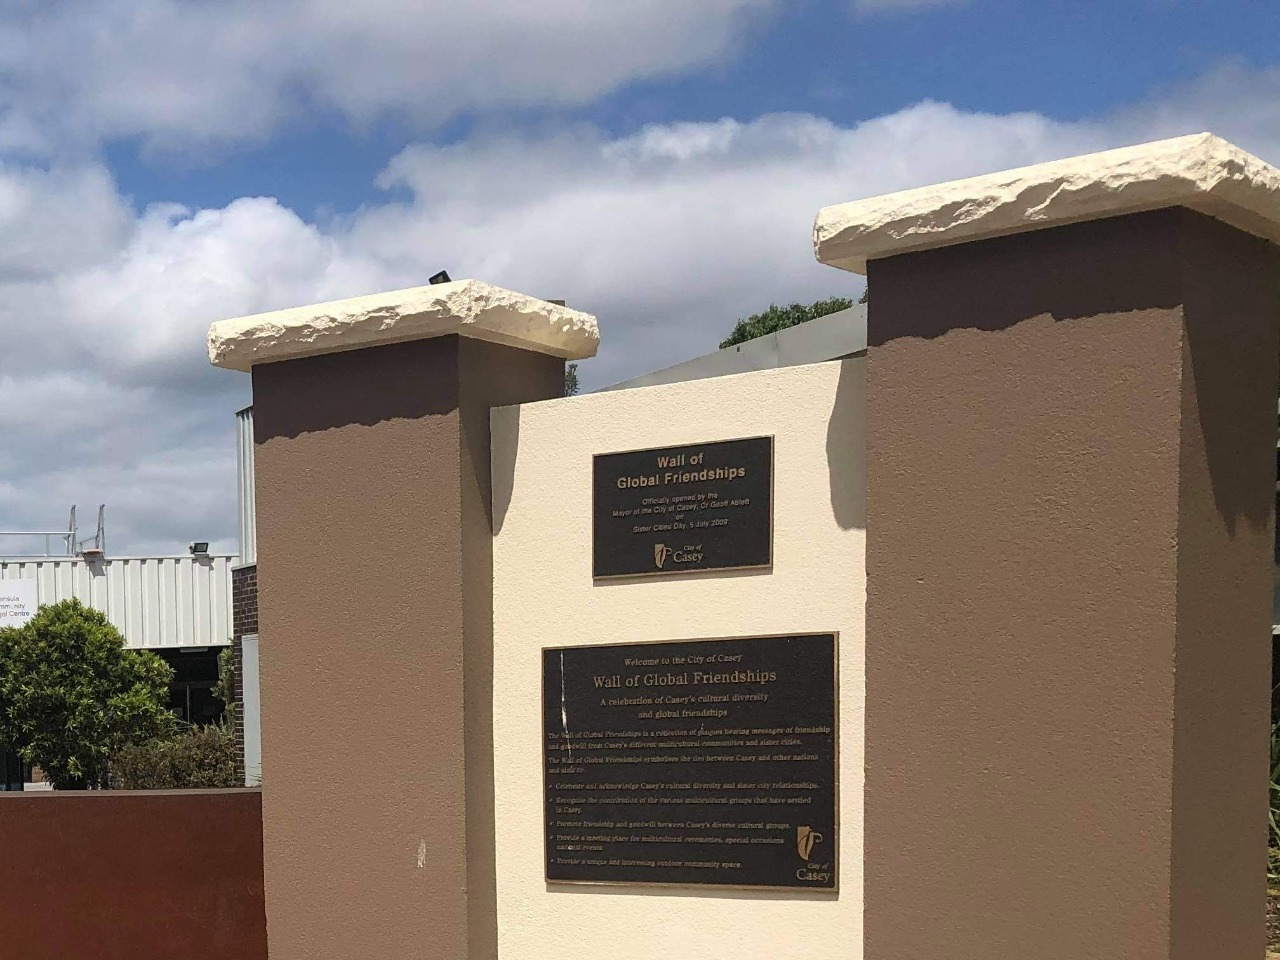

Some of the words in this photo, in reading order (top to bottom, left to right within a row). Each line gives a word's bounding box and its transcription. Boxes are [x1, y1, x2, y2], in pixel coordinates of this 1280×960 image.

[657, 454, 684, 468] Wall
[690, 453, 704, 464] of
[617, 474, 660, 488] Global
[664, 467, 746, 485] Friendships
[672, 494, 696, 503] opened
[698, 493, 706, 501] by
[654, 506, 666, 514] City
[710, 518, 728, 526] 2009
[674, 550, 704, 563] Casey
[624, 658, 659, 666] Welcome
[672, 656, 684, 664] the
[688, 656, 704, 664] City
[706, 655, 716, 663] of
[718, 654, 742, 662] Casey
[594, 676, 621, 688] Wall
[626, 675, 640, 687] of
[644, 672, 688, 686] Global
[694, 670, 777, 684] Friendships
[608, 696, 652, 706] celebration
[654, 696, 664, 704] of
[666, 696, 694, 704] Casey's
[698, 694, 730, 703] cultural
[732, 693, 769, 702] diversity
[638, 710, 653, 718] and
[655, 710, 680, 720] global
[682, 708, 728, 718] friendships
[794, 726, 830, 734] friendship
[796, 868, 831, 883] Casey
